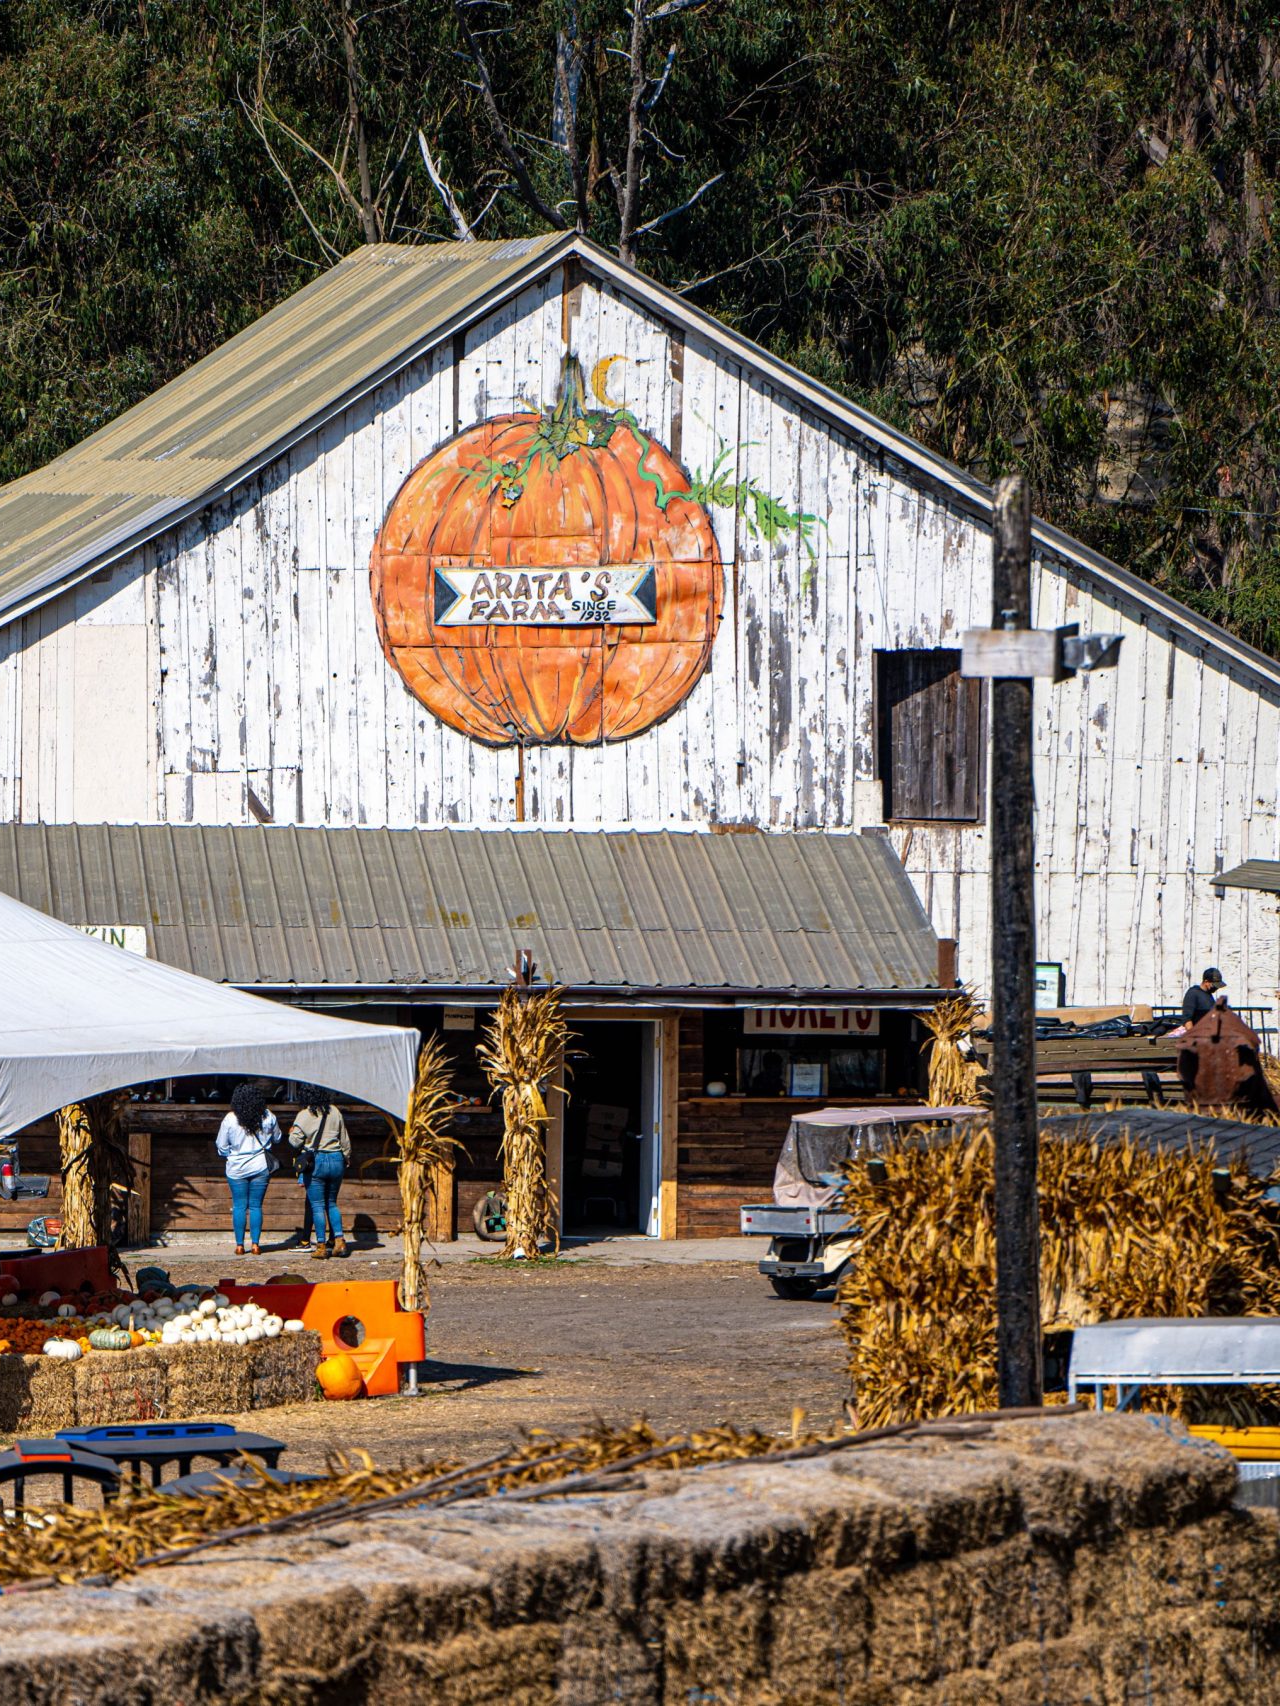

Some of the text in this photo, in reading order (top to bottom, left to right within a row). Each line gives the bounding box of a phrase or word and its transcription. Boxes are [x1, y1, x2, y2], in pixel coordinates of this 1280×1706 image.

[470, 571, 612, 602] ARATA'S
[468, 600, 566, 621] FARM
[571, 600, 617, 611] SINCE
[579, 611, 612, 622] 1932
